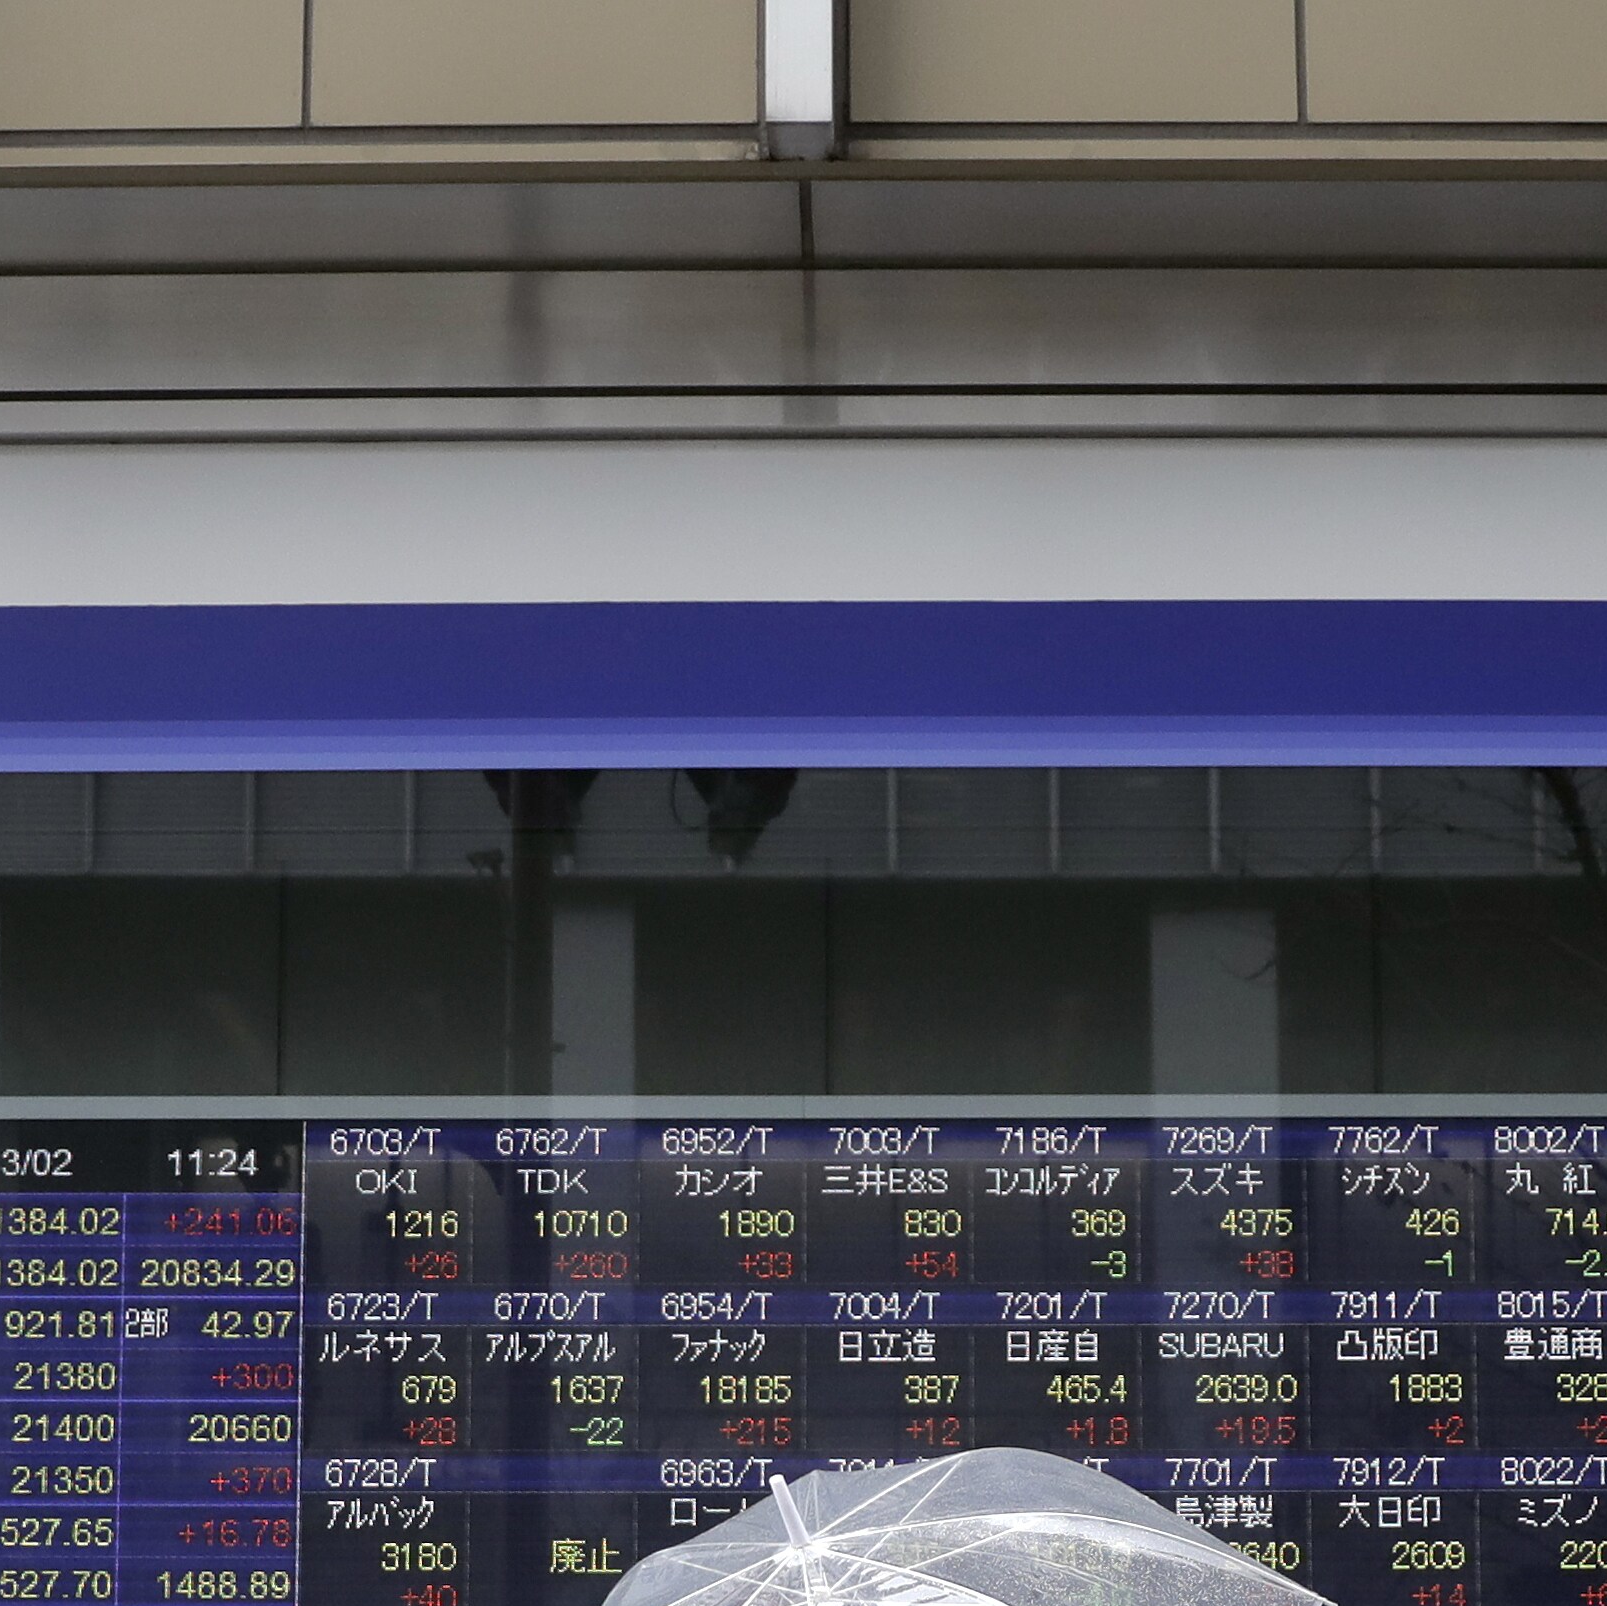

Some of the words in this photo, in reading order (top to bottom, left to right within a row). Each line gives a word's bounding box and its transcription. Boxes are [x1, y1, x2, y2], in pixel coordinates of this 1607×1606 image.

[496, 1125, 608, 1156] 6762/T
[1162, 1124, 1274, 1155] 7269/T
[0, 1148, 75, 1177] 3/02
[167, 1148, 260, 1177] 11:24
[355, 1168, 418, 1195] OKI
[516, 1168, 589, 1194] TDK
[675, 1163, 764, 1197] カシオ
[821, 1163, 949, 1196] 三井E&S
[1170, 1162, 1264, 1196] スズキ
[164, 1205, 295, 1237] +241.06
[534, 1209, 628, 1238] 10710
[1071, 1208, 1126, 1237] 369
[1220, 1208, 1293, 1237] 4375
[140, 1258, 296, 1287] 20834.29
[661, 1289, 774, 1321] 6954/T
[1330, 1288, 1443, 1320] 7911/T
[5, 1310, 116, 1339] 921.81
[201, 1310, 295, 1339] 42.97
[318, 1328, 447, 1363] ルネサス
[671, 1328, 766, 1363] ファナック
[838, 1328, 936, 1363] 日立造
[1006, 1328, 1099, 1363] 日産自
[1158, 1332, 1284, 1359] SUBARU
[1336, 1327, 1439, 1362] 凸版印
[1503, 1326, 1603, 1361] 豊通商
[13, 1361, 116, 1390] 21380
[208, 1362, 296, 1390] +300
[550, 1375, 624, 1404] 1637
[11, 1413, 115, 1442] 21400
[187, 1414, 292, 1443] 20660
[720, 1416, 792, 1446] +215
[10, 1465, 114, 1494] 21350
[206, 1466, 294, 1494] +370
[324, 1456, 438, 1488] 6728/T
[326, 1495, 435, 1530] アルバック
[1338, 1493, 1441, 1528] 大日印
[1517, 1493, 1599, 1528] ミズノ
[177, 1518, 293, 1549] +16.78
[381, 1542, 457, 1572] 3180
[549, 1537, 624, 1575] 廃止
[157, 1570, 291, 1600] 1488.89
